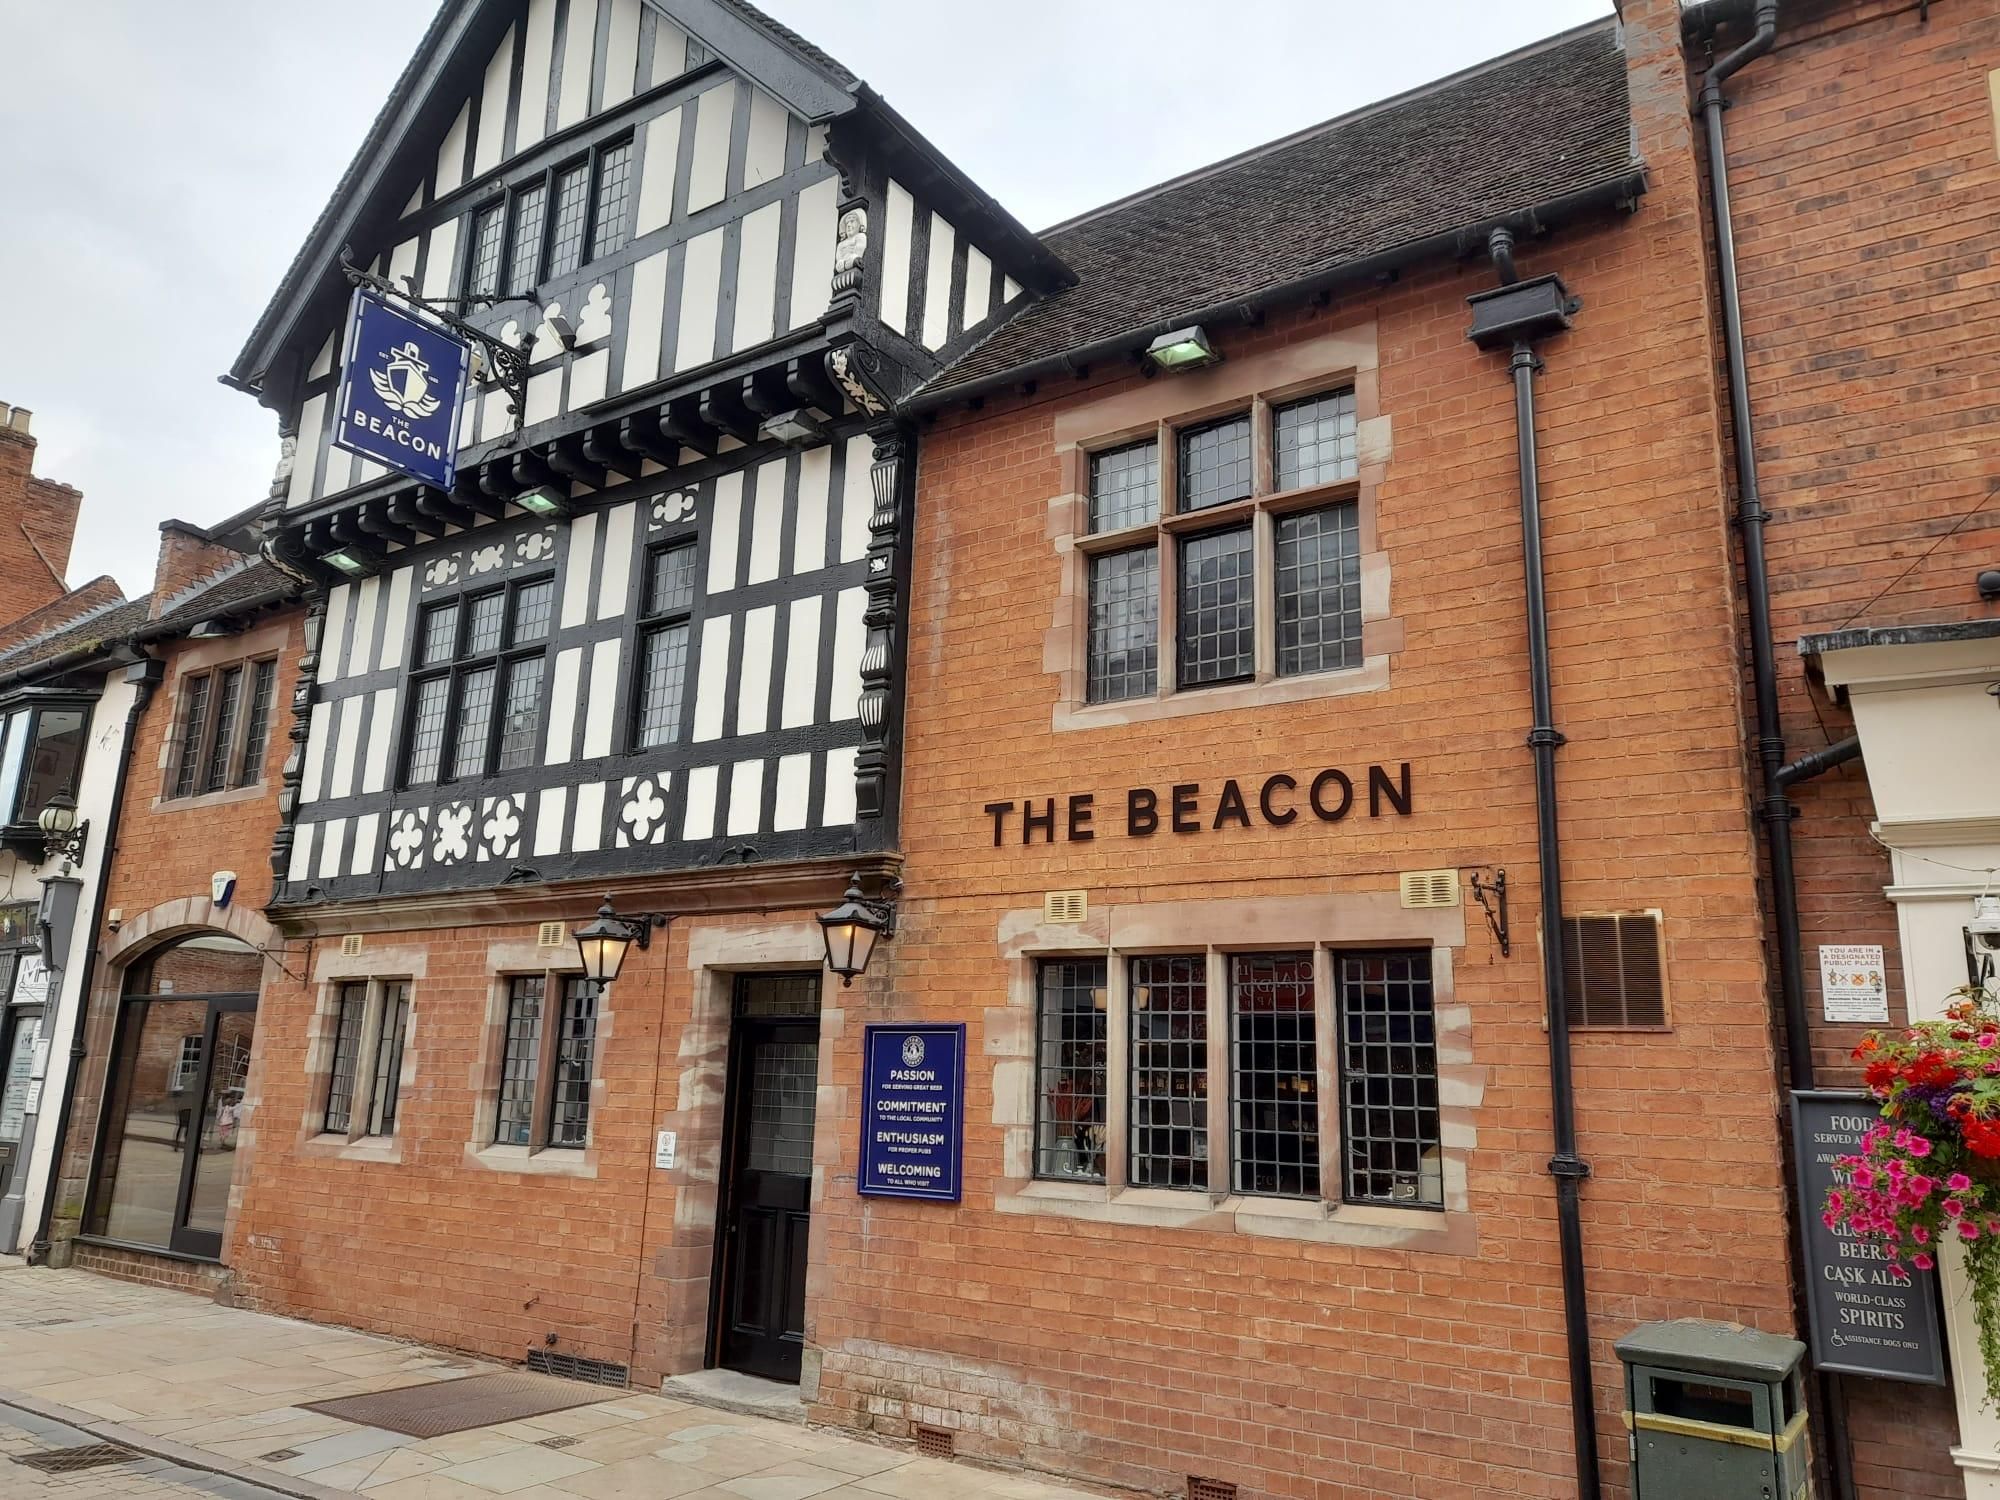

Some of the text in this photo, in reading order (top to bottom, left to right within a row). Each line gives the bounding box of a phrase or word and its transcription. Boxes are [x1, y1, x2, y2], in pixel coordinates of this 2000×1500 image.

[391, 415, 410, 429] THE
[353, 409, 441, 460] BEACON
[984, 762, 1413, 847] THE BEACON
[890, 1069, 935, 1081] PASSION
[877, 1100, 947, 1113] COMMITMENT
[1830, 1115, 1873, 1132] FOOD
[876, 1131, 945, 1145] ENTHUSIASM
[1814, 1133, 1852, 1145] SERVED
[878, 1163, 941, 1178] WELCOMING
[1824, 1265, 1866, 1284] CASK
[1834, 1291, 1906, 1308] WORLD-CLASS
[1840, 1308, 1905, 1330] SPIRITS
[1844, 1334, 1919, 1350] ASSISTANCE DOGS ONLY
